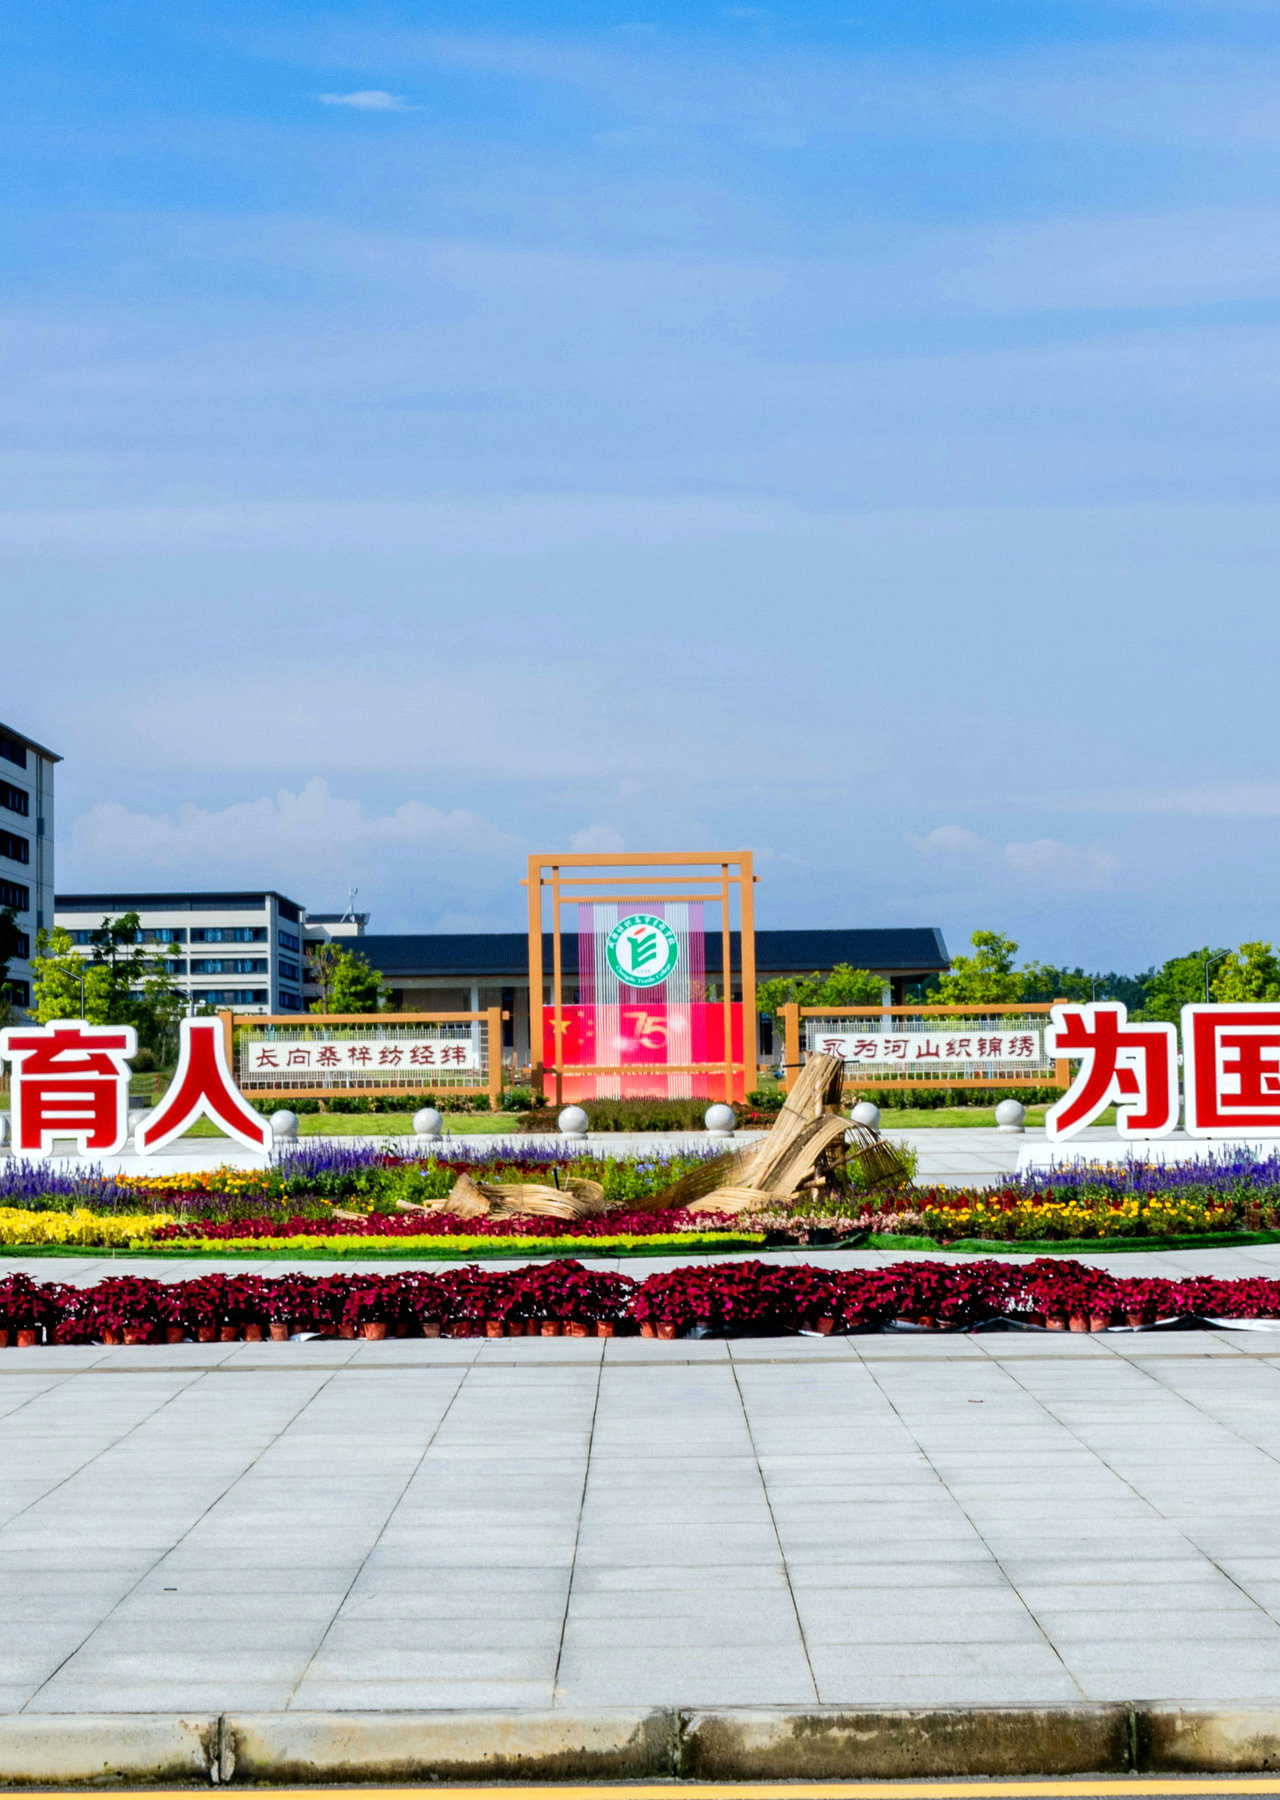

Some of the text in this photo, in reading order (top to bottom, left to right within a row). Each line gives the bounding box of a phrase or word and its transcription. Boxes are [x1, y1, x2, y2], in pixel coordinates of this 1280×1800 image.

[623, 1011, 669, 1049] 75
[255, 1045, 467, 1068] 长向桑梓纺经纬
[822, 1036, 1035, 1059] 永为河山织锦绣
